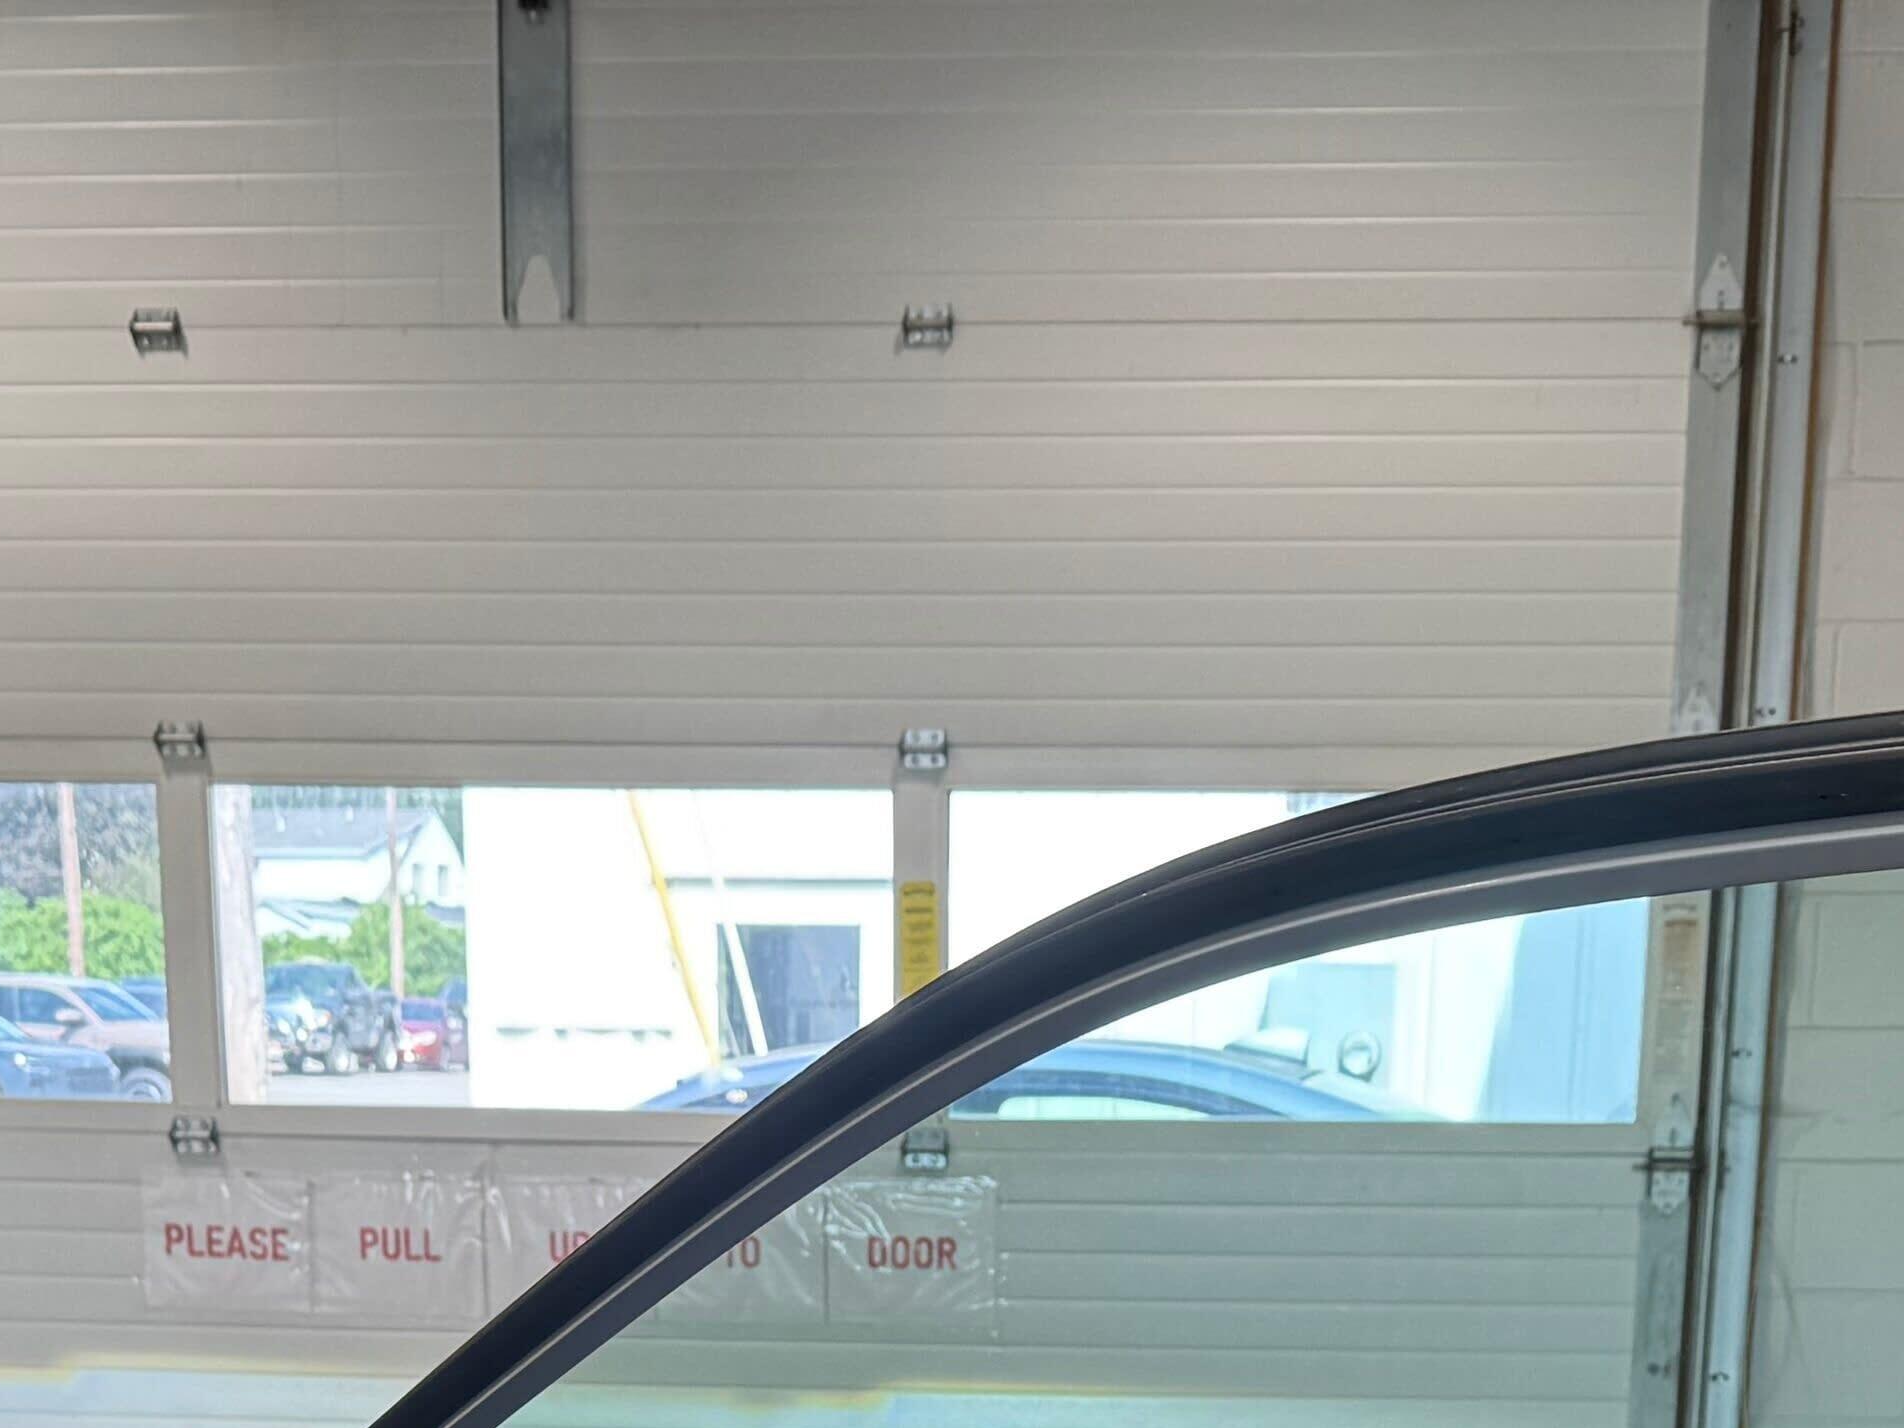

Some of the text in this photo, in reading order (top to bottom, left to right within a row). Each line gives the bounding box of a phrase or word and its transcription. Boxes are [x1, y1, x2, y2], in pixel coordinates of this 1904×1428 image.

[164, 1222, 290, 1262] PLEASE
[359, 1226, 442, 1262] PULL
[867, 1235, 958, 1271] DOOR
